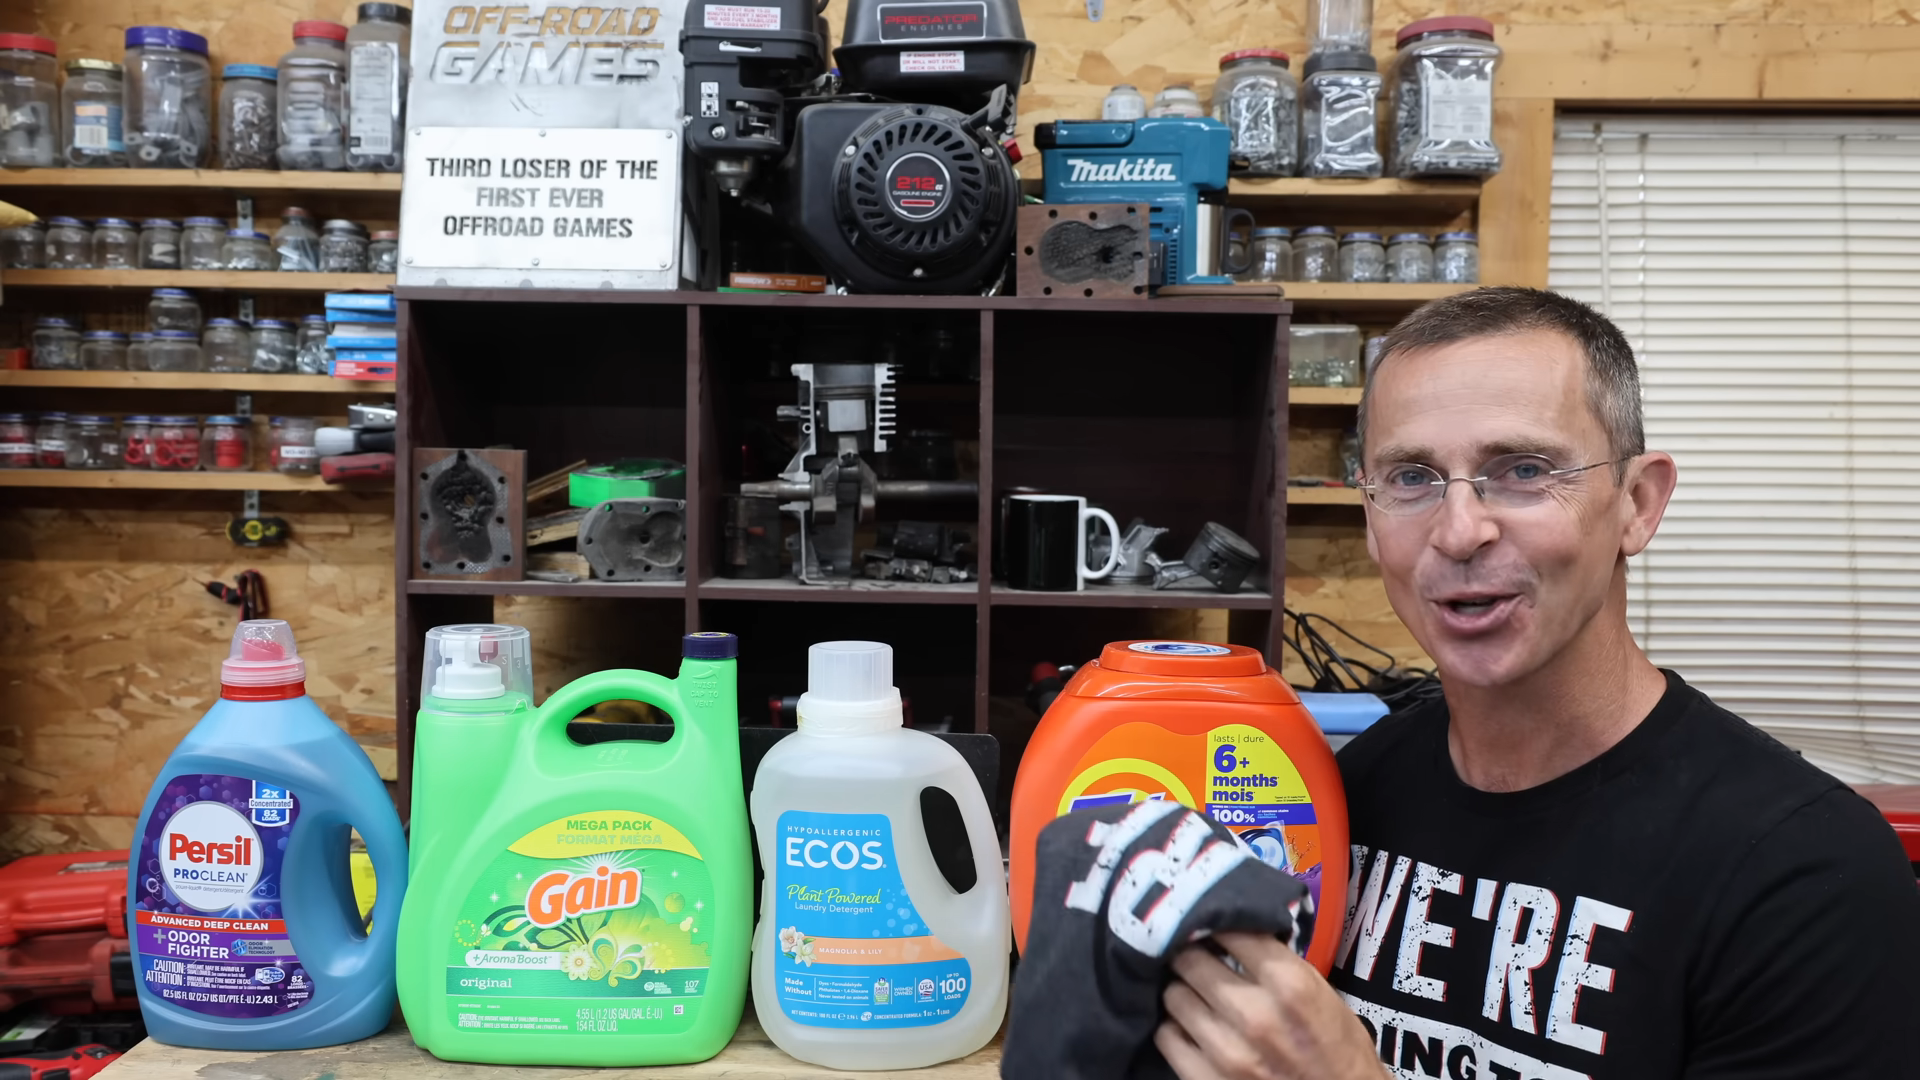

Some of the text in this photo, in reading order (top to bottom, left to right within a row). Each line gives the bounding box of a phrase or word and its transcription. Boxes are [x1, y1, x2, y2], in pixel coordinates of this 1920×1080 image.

[443, 5, 660, 36] OFF-ROAD
[884, 14, 978, 25] PREDATOR
[430, 41, 664, 84] GAMES
[426, 158, 658, 180] THIRD LOSER OF THE
[476, 187, 604, 208] FIRST EVER
[443, 216, 633, 238] OFFROAD GAMES
[261, 789, 280, 798] 2x
[1212, 809, 1255, 823] 100%
[566, 820, 652, 831] MEGA PACK
[787, 826, 881, 836] HYPOALLERGENIC
[556, 832, 662, 845] FORMAT MÉGA
[528, 866, 639, 925] Gain
[786, 884, 882, 904] Plant Powered
[795, 901, 873, 915] Laundry Detergent
[151, 915, 201, 928] ADVANCED
[233, 922, 268, 930] CLEAN
[168, 930, 210, 945] ODOR
[168, 943, 229, 958] FIGHTER
[1334, 844, 1634, 1056] WE'RE
[460, 978, 512, 990] original
[785, 977, 803, 986] Made
[939, 978, 966, 994] 100
[785, 986, 812, 995] Without
[256, 995, 273, 1004] 2.43
[274, 995, 278, 1004] L
[576, 1008, 590, 1019] 4.55
[609, 1008, 616, 1019] US
[576, 1020, 588, 1031] 154
